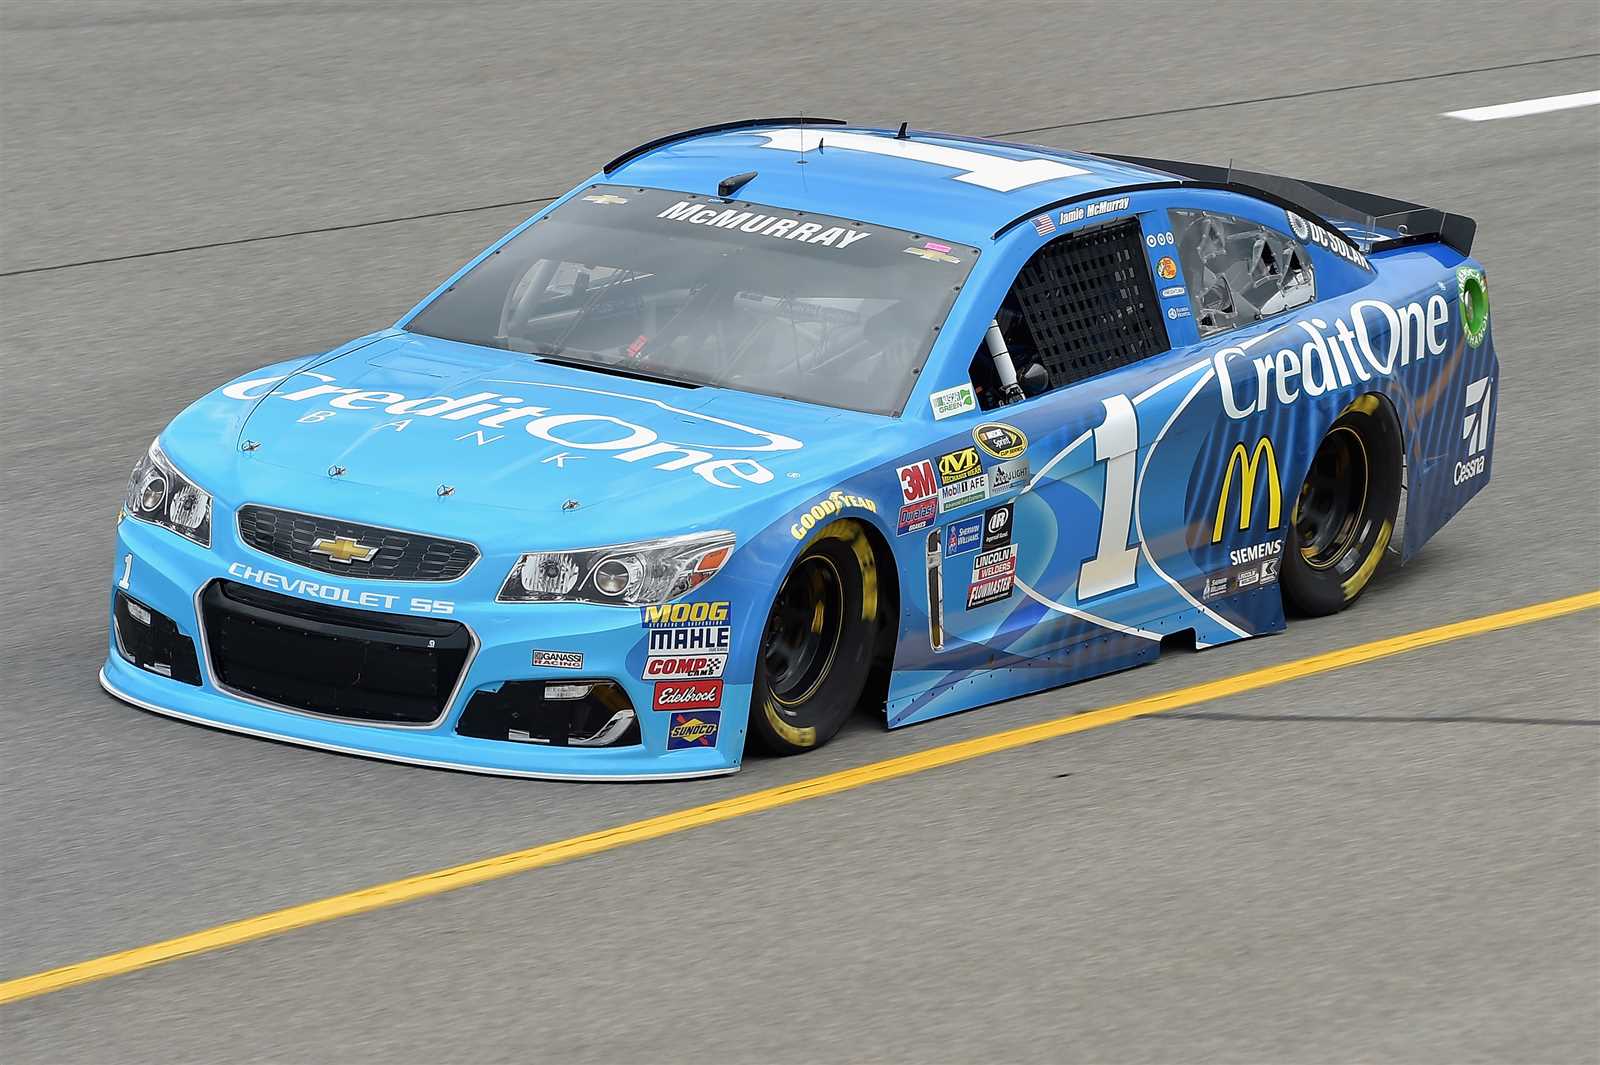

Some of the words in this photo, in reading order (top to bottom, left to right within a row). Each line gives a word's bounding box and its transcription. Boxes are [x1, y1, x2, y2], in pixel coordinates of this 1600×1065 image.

[1059, 208, 1084, 225] Jamie
[1087, 197, 1130, 218] McMurray
[993, 436, 1011, 449] Sprint
[901, 461, 937, 501] 3M
[1454, 455, 1485, 486] Cessna
[942, 483, 960, 499] Mobil
[970, 477, 985, 490] AFE
[1078, 393, 1141, 601] 1
[791, 491, 877, 540] GOODYEAR
[975, 548, 1010, 569] LINCOLN
[1230, 540, 1282, 566] SIEMENS
[118, 553, 133, 589] 1
[981, 562, 1011, 578] WELDERS
[228, 562, 401, 610] CHEVROLET
[410, 599, 455, 615] SS
[968, 575, 1012, 608] FLOWMASTER
[644, 602, 730, 624] MOOG
[650, 627, 729, 650] MAHLE
[647, 658, 707, 675] COMP
[687, 669, 715, 677] CAMS
[658, 686, 717, 704] Edelbrock
[672, 725, 716, 737] SUNOCO
